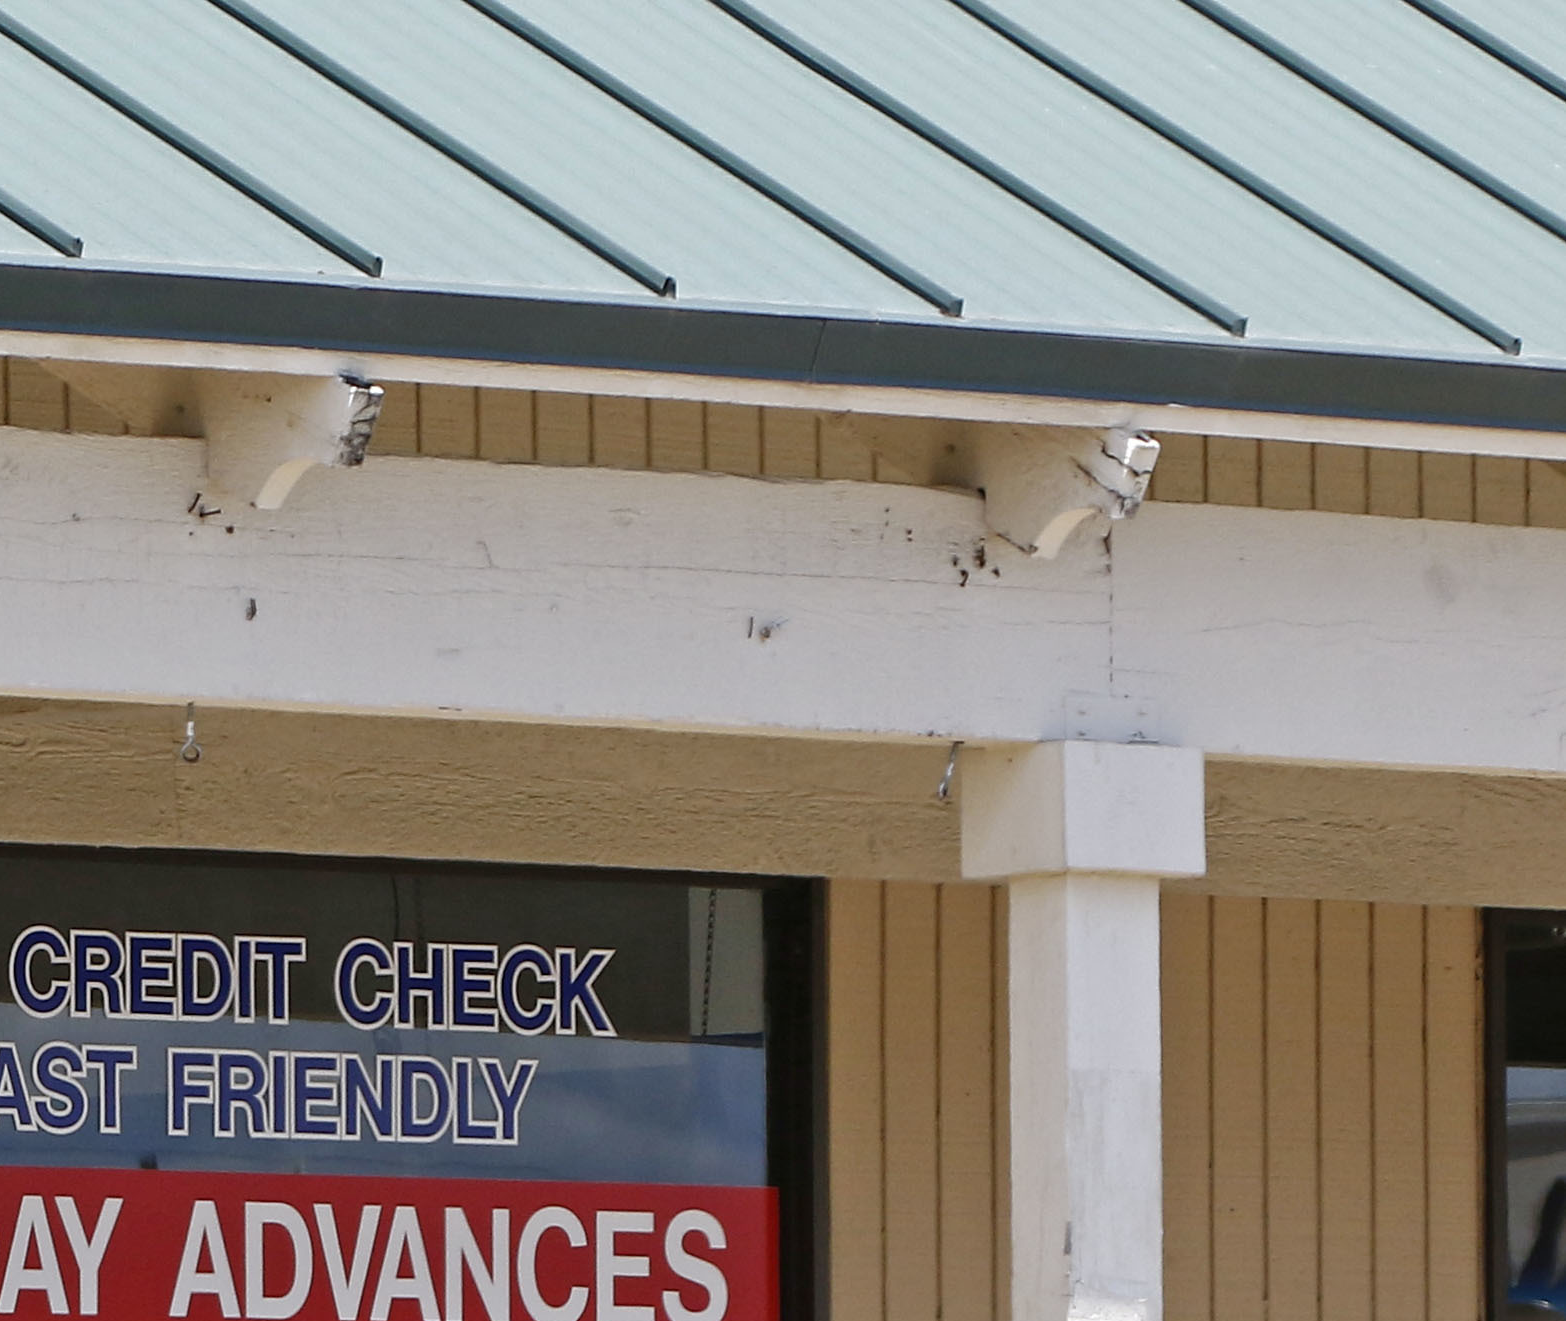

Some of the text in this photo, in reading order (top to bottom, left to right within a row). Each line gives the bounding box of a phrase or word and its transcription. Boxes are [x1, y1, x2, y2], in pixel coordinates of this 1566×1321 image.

[9, 925, 305, 1025] CREDIT
[334, 937, 616, 1036] CHECK
[165, 1049, 539, 1146] FRIENDLY
